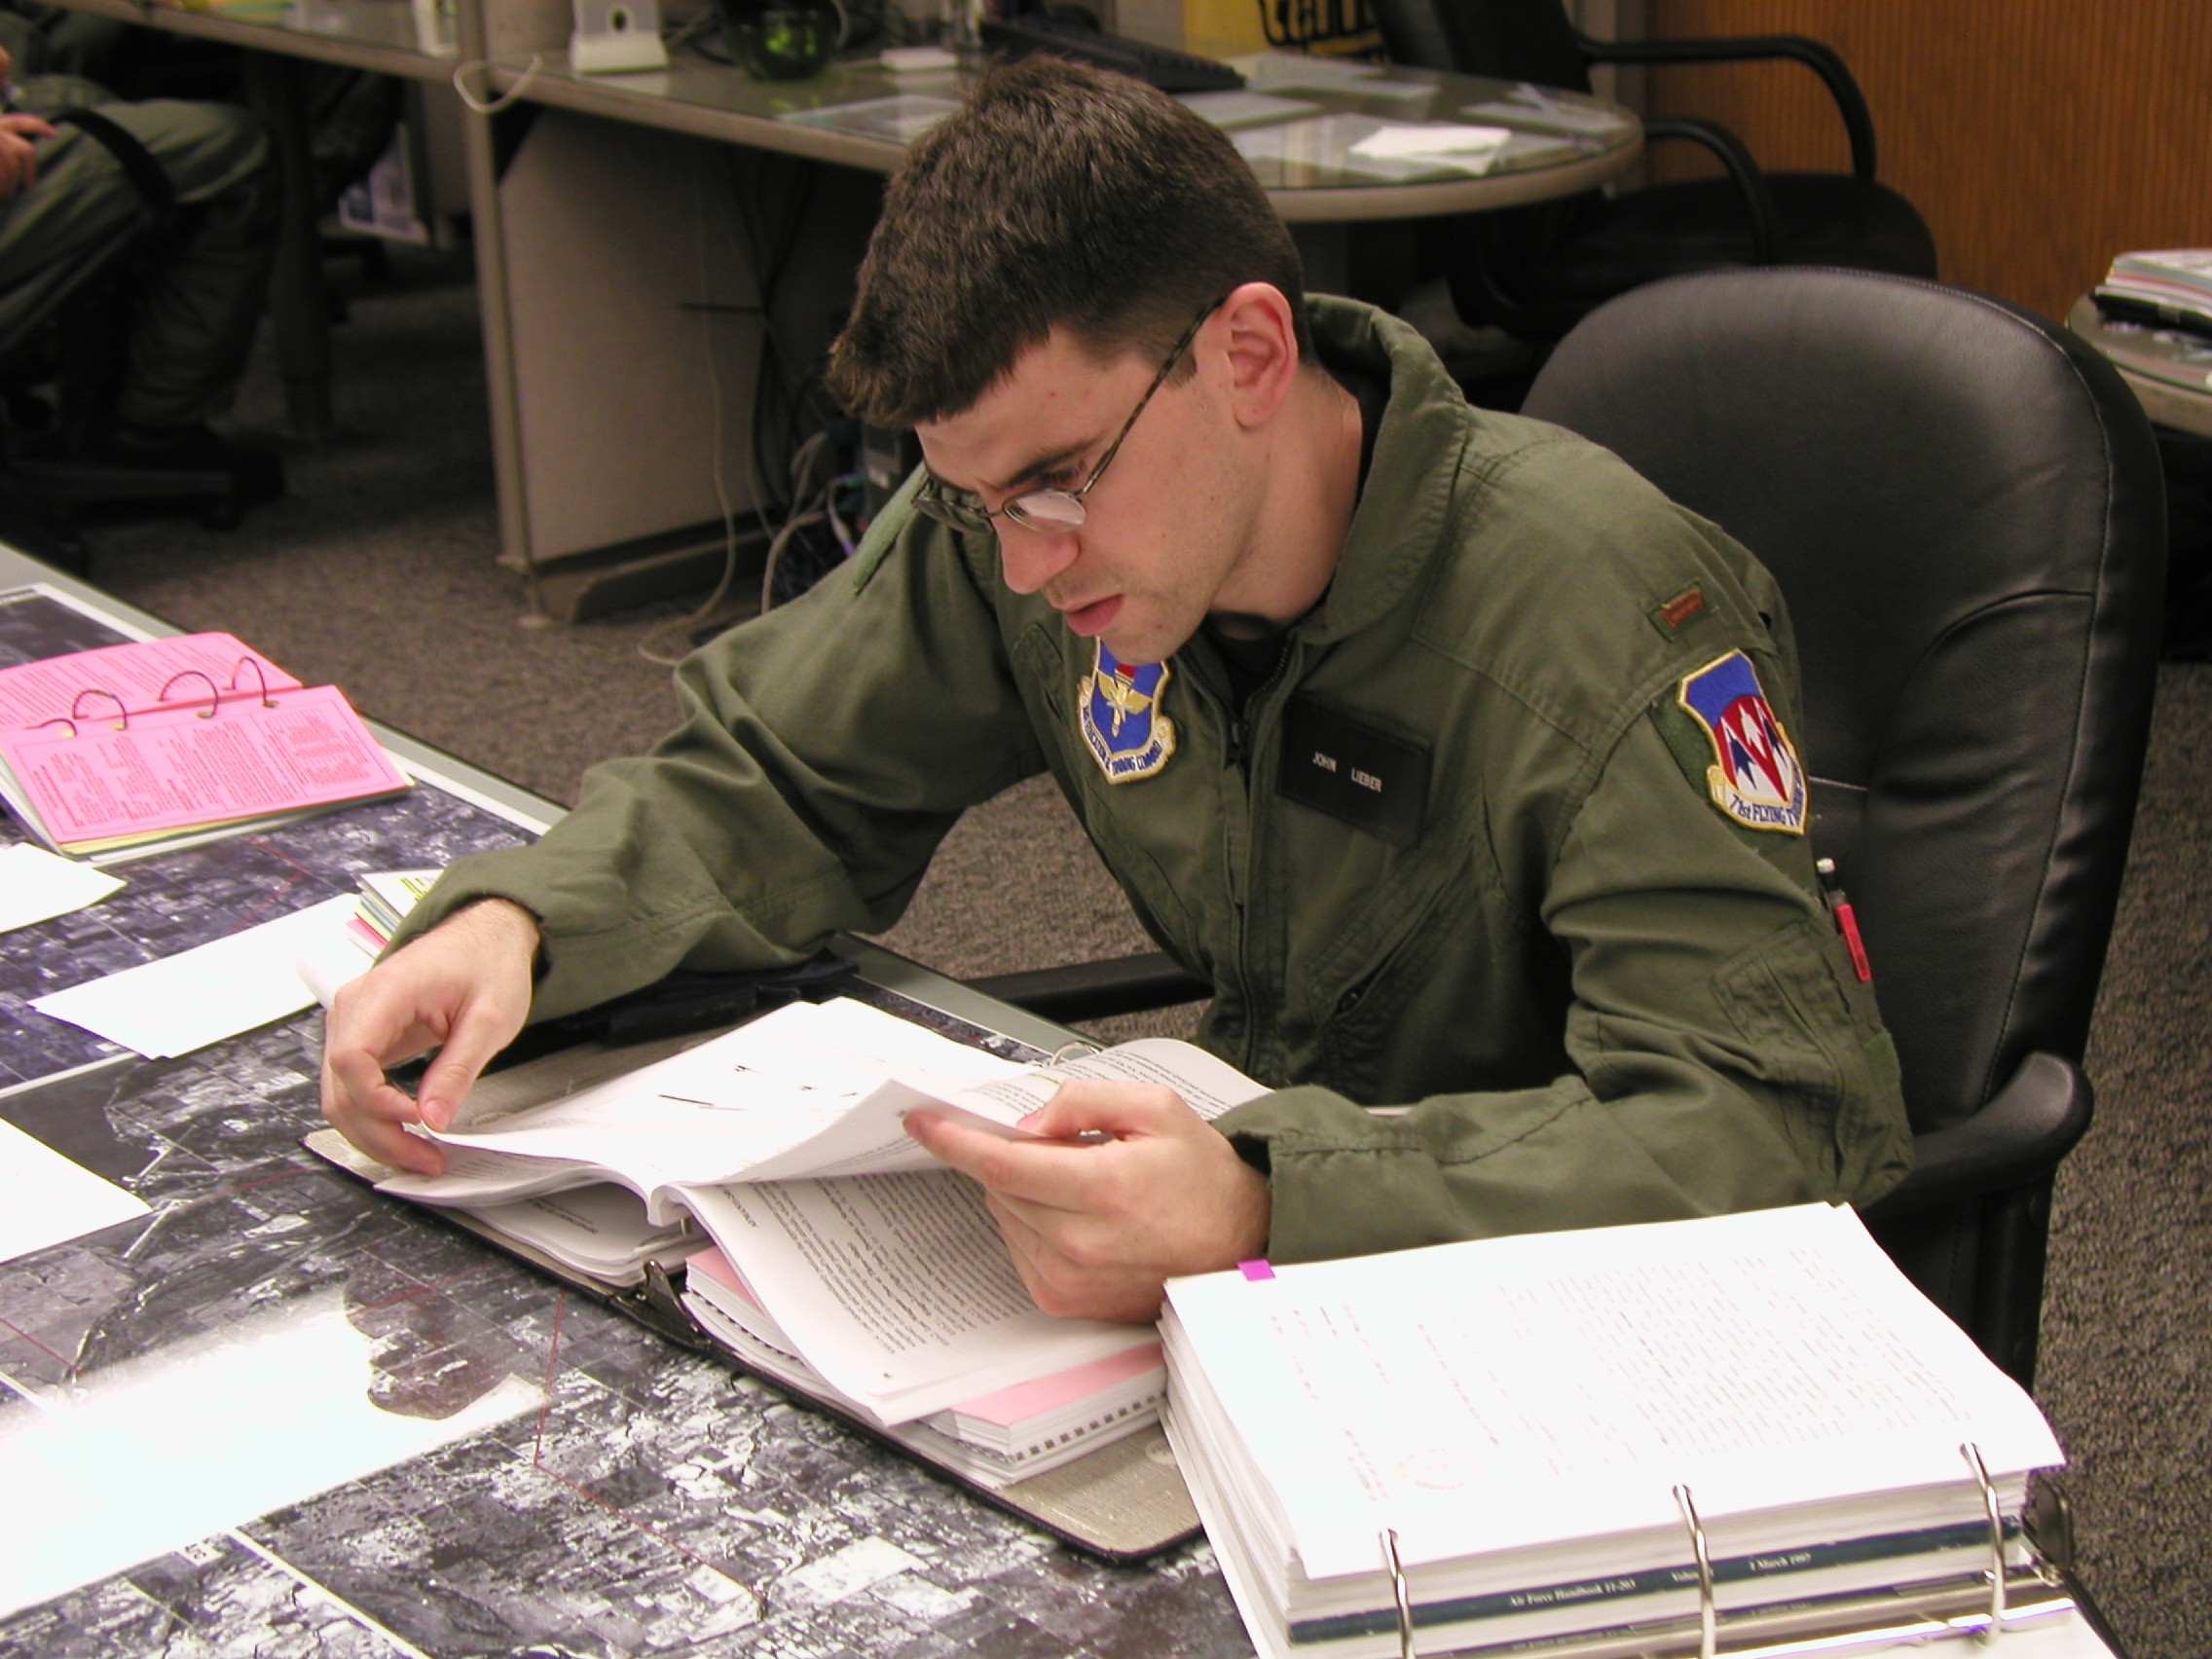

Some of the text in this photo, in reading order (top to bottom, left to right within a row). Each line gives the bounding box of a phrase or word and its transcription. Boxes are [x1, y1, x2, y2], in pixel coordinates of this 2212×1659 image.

[1311, 751, 1337, 773] JOHN
[1752, 801, 1787, 826] FLYING
[1527, 1592, 1554, 1605] Force
